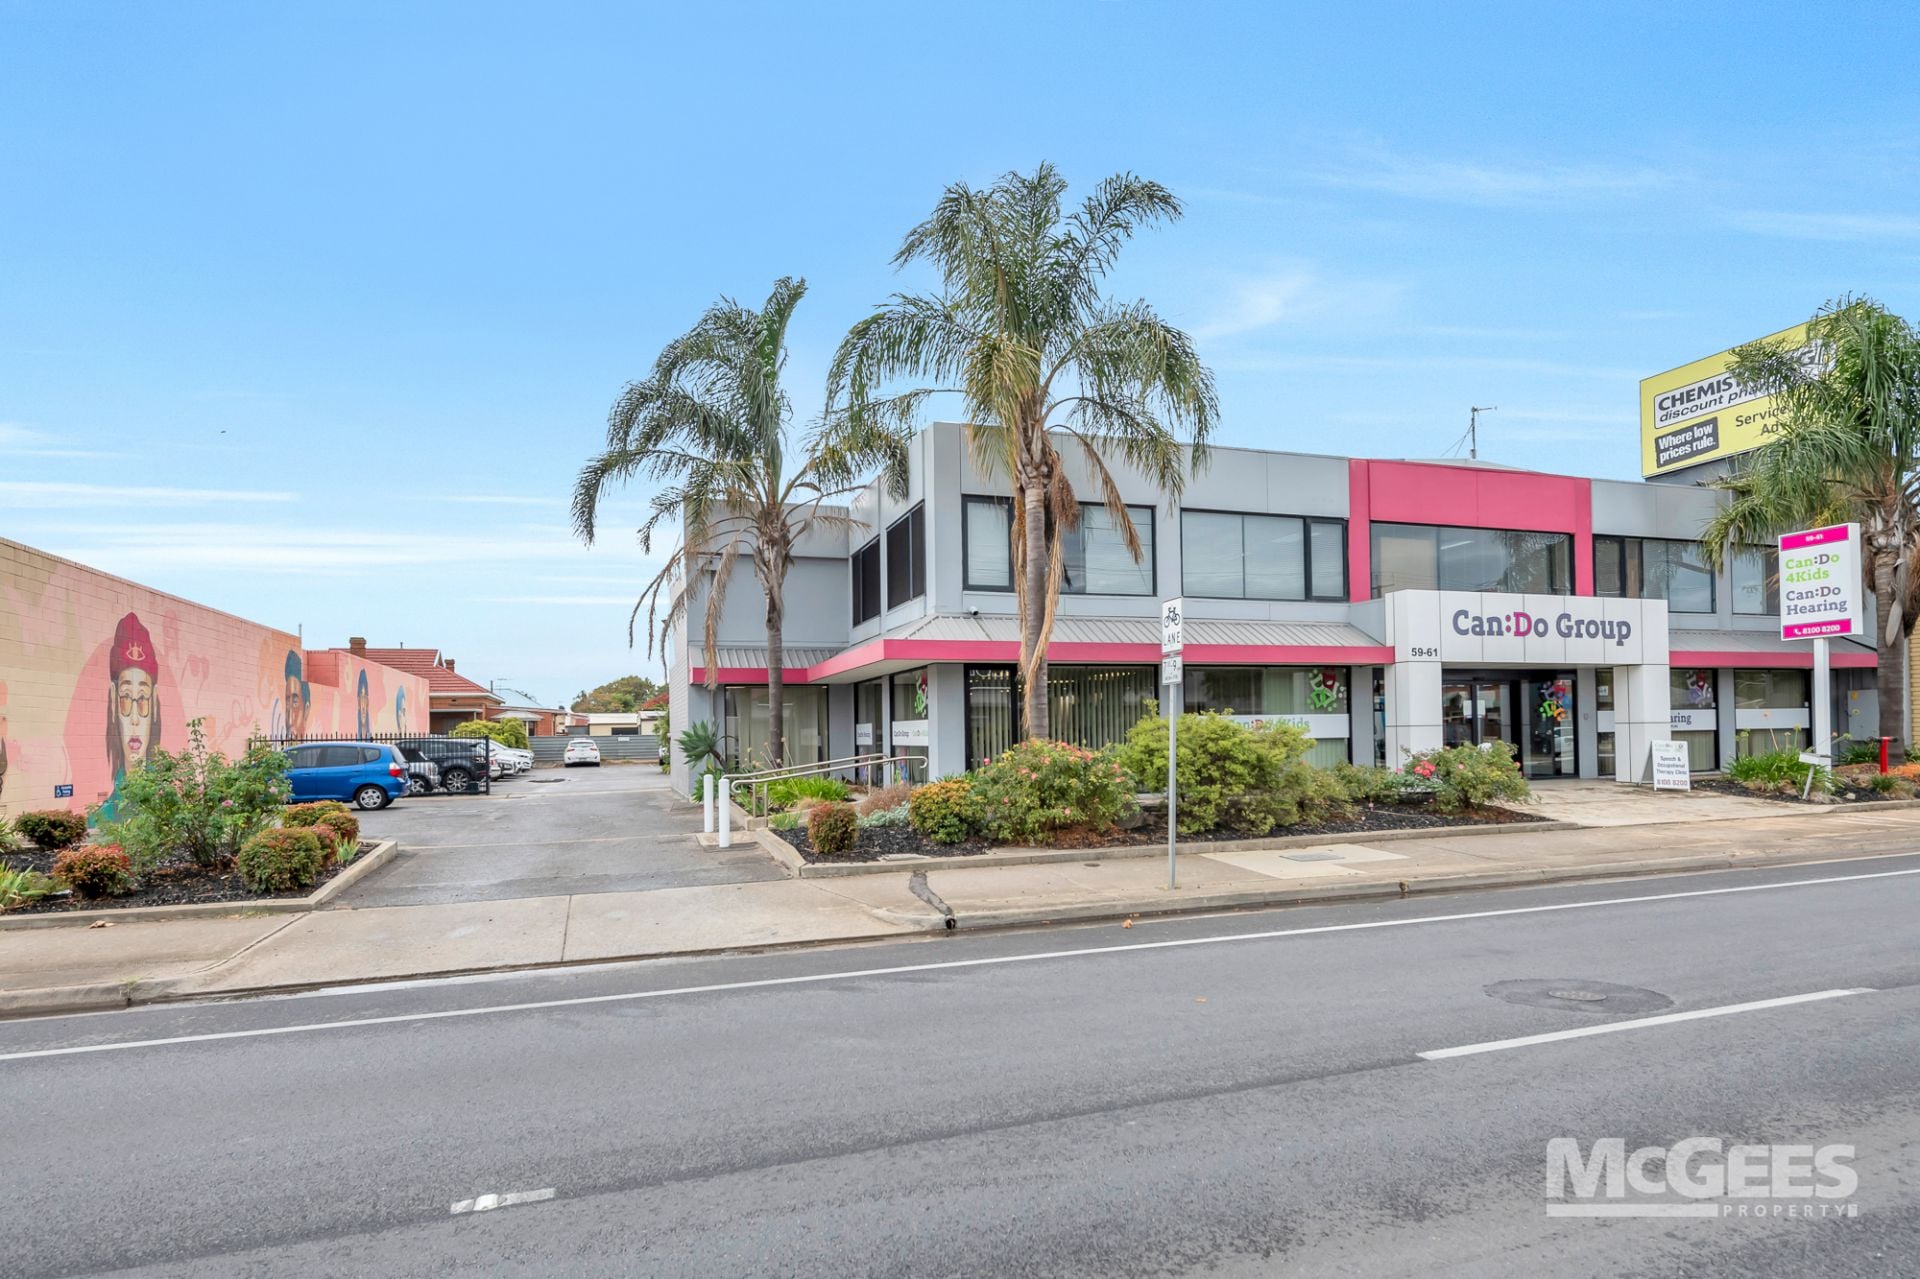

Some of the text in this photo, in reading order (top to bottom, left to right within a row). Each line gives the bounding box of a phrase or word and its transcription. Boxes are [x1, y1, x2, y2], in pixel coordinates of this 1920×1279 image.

[1658, 376, 1743, 411] CHEMIS
[1660, 395, 1724, 422] discount
[1658, 424, 1713, 451] Where low
[1659, 436, 1716, 464] prices rule.
[1805, 533, 1824, 542] 59-61
[1785, 553, 1841, 570] Can:Do
[1785, 567, 1830, 583] 4Kids
[1786, 586, 1841, 601] Can:Do
[1786, 600, 1848, 616] Hearing
[1452, 609, 1632, 647] Can:Do Group
[1802, 624, 1840, 635] 8100 8200
[1163, 631, 1180, 646] LANE
[1411, 647, 1438, 657] 59-61
